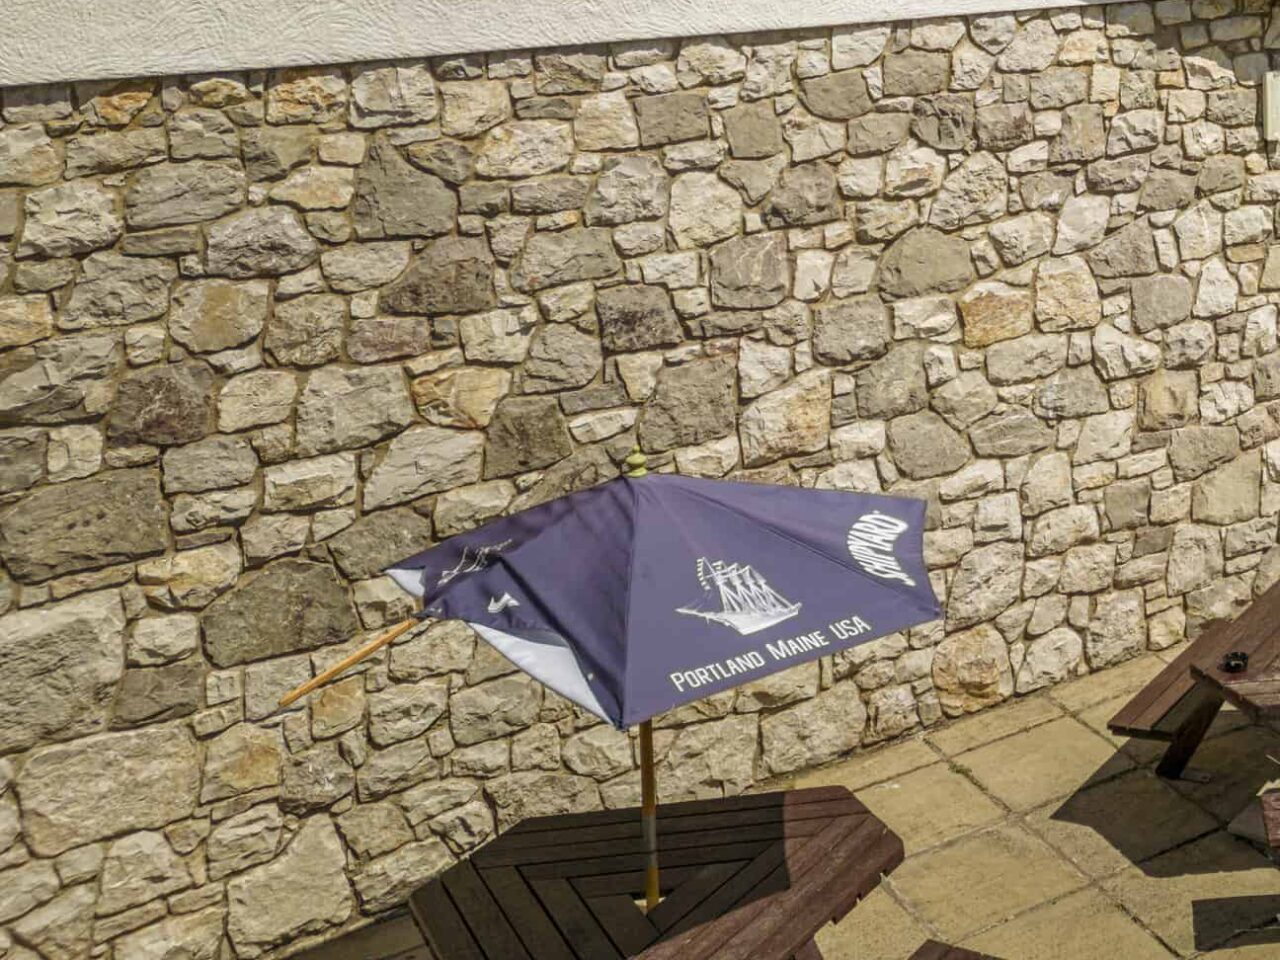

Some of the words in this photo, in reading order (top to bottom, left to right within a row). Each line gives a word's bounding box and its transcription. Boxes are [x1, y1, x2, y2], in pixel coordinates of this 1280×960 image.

[847, 512, 916, 587] SHIPYARD
[669, 651, 765, 692] PORTLAND
[765, 630, 830, 661] MAINE
[828, 615, 872, 640] USA
